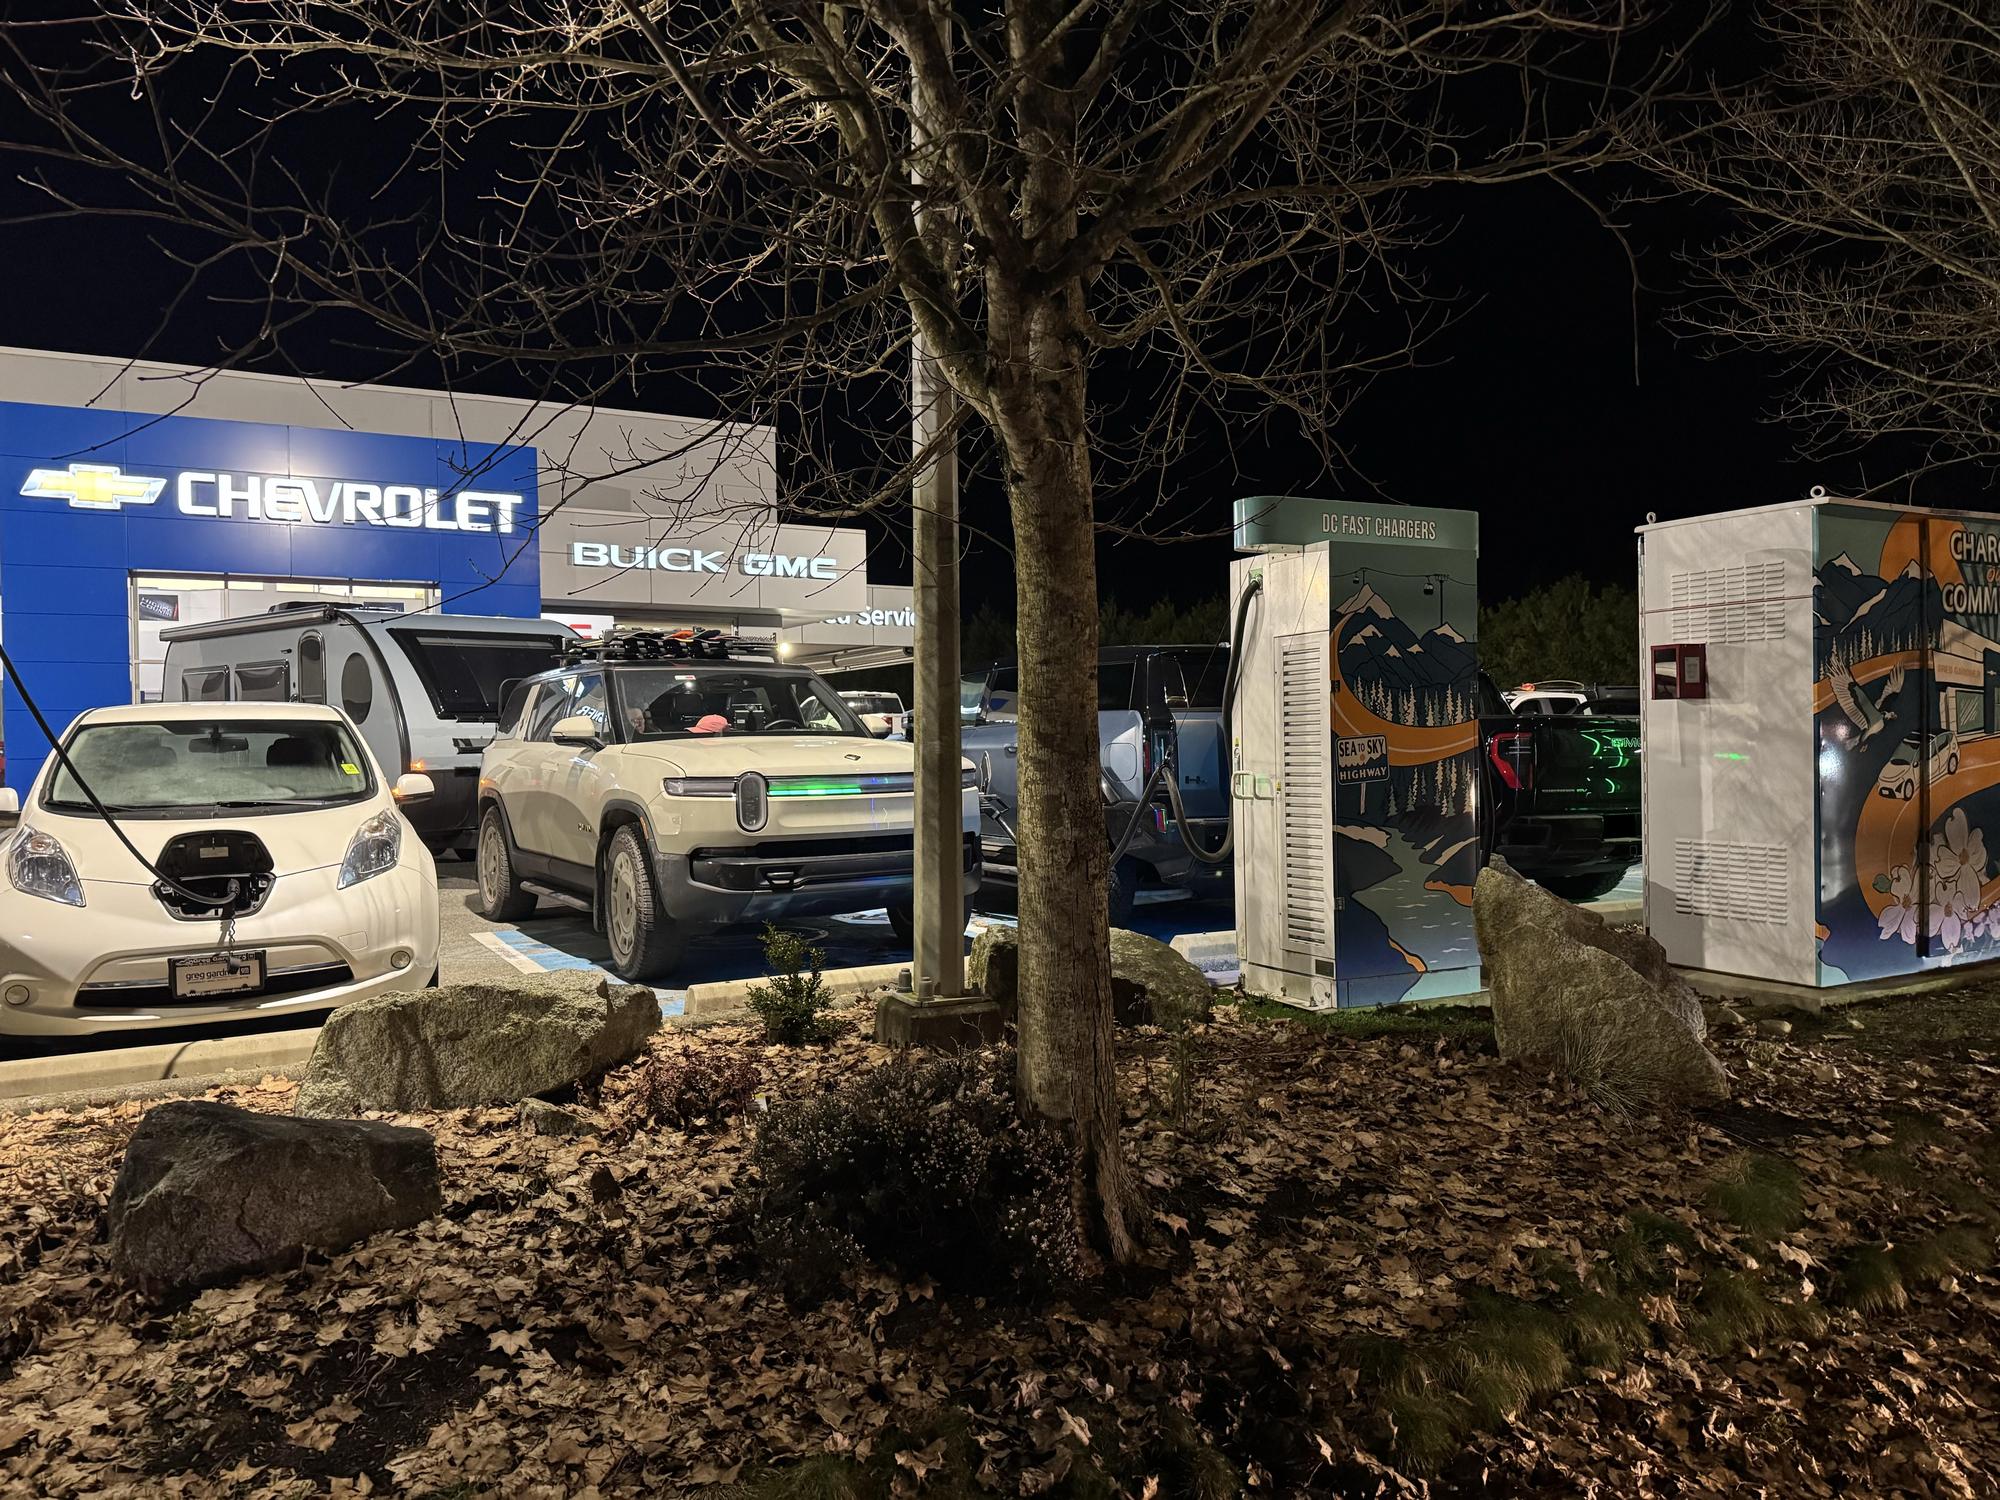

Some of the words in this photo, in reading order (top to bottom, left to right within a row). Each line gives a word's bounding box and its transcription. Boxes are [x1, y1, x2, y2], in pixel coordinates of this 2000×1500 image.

[177, 471, 523, 533] CHEVROLET
[1322, 513, 1338, 533] DC
[1342, 515, 1371, 535] FAST
[1375, 517, 1436, 540] CHARGERS
[573, 541, 727, 573] BUICK
[743, 552, 837, 579] GMC
[1950, 531, 2000, 563] CHAR
[1942, 584, 2000, 615] COMM
[1339, 741, 1357, 757] SEA
[1358, 743, 1365, 752] TO
[1367, 739, 1385, 754] SKY
[1340, 766, 1387, 781] HIGHWAY
[185, 971, 205, 982] greg
[206, 968, 230, 980] gardn
